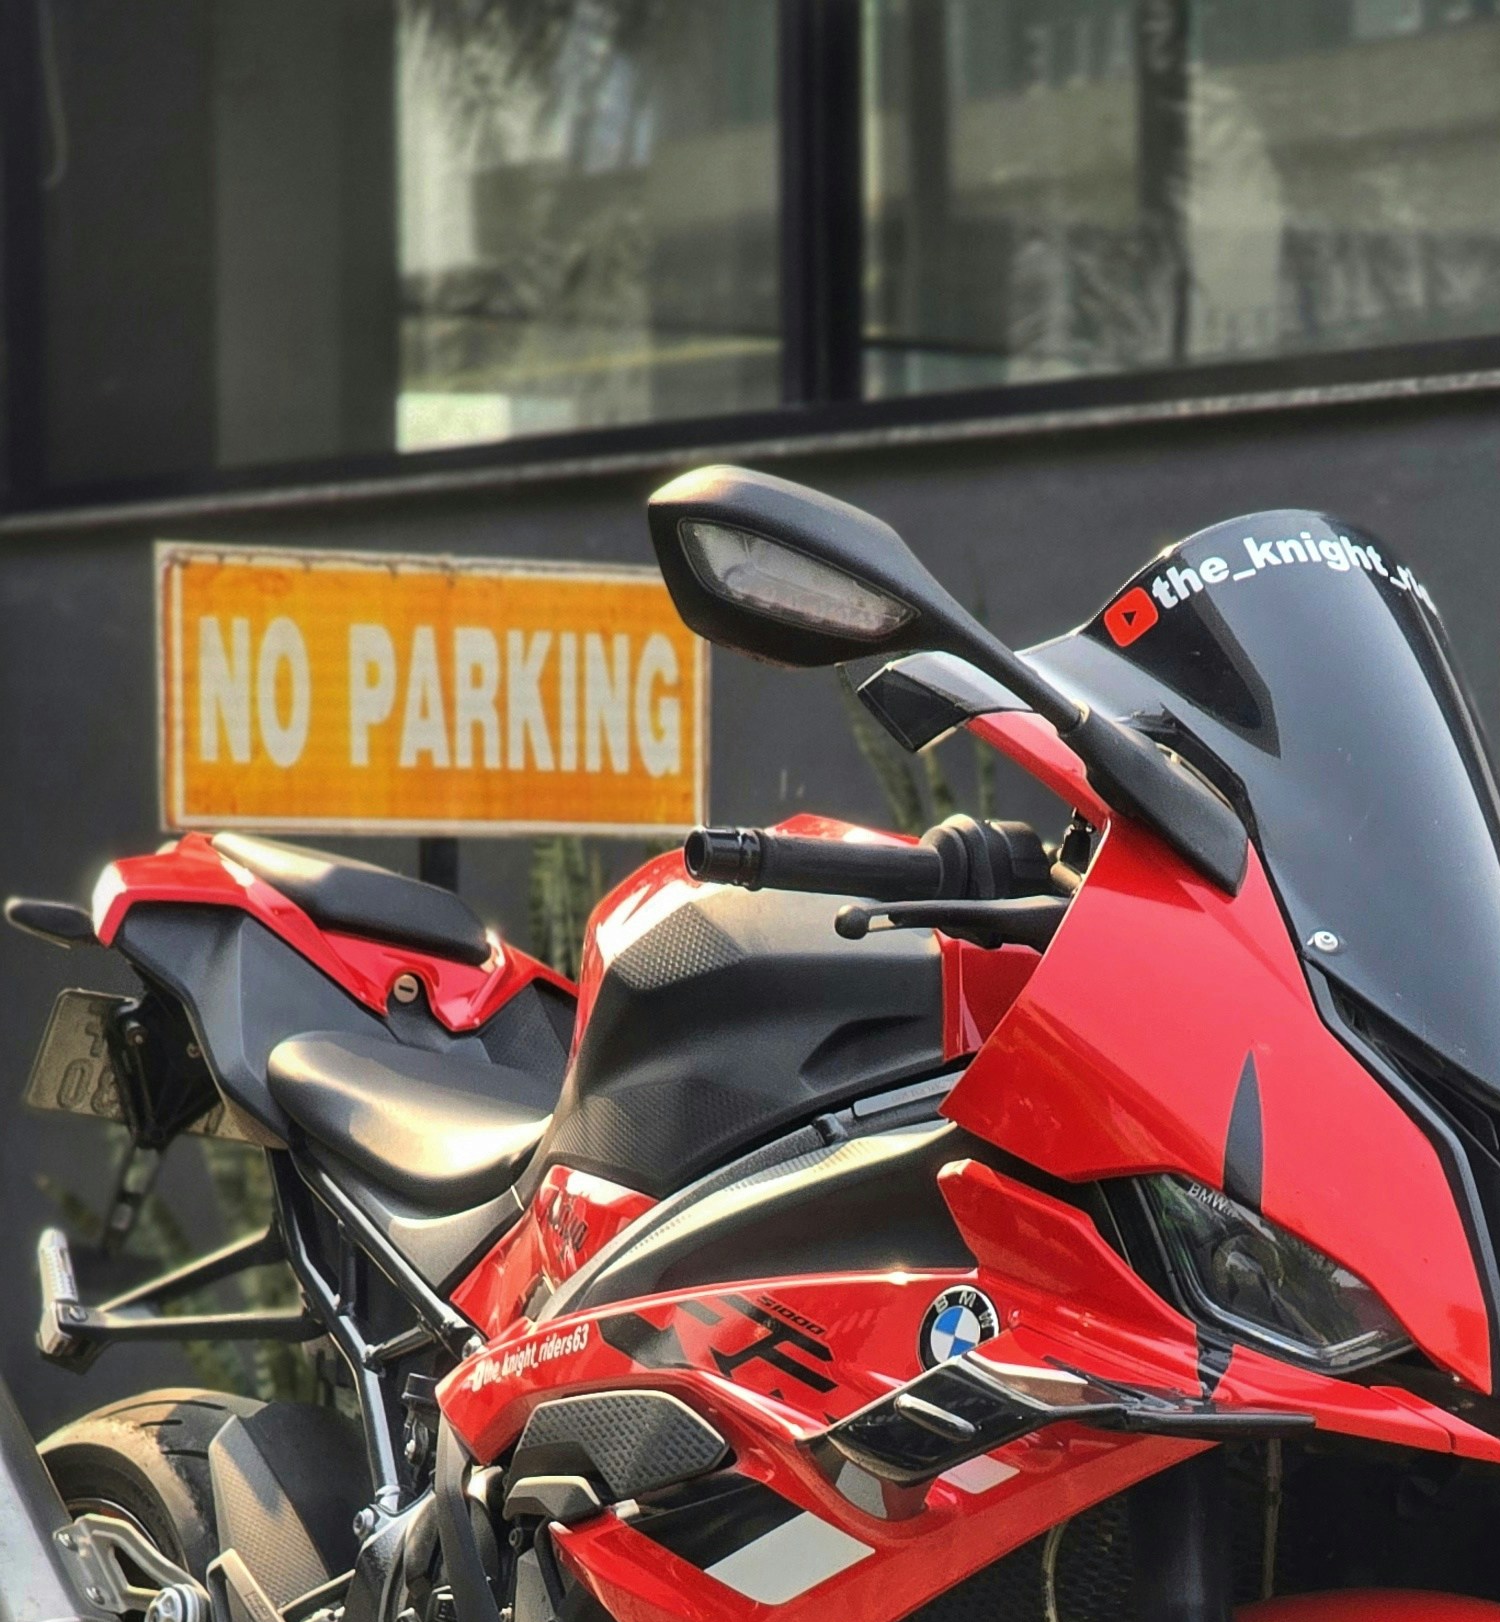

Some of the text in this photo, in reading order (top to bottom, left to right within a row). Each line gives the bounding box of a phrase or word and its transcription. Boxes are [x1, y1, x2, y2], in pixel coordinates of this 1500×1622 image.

[200, 615, 681, 777] NO PARKING
[1186, 1182, 1228, 1211] BMW
[757, 1295, 826, 1335] S1000
[934, 1290, 994, 1329] BMW
